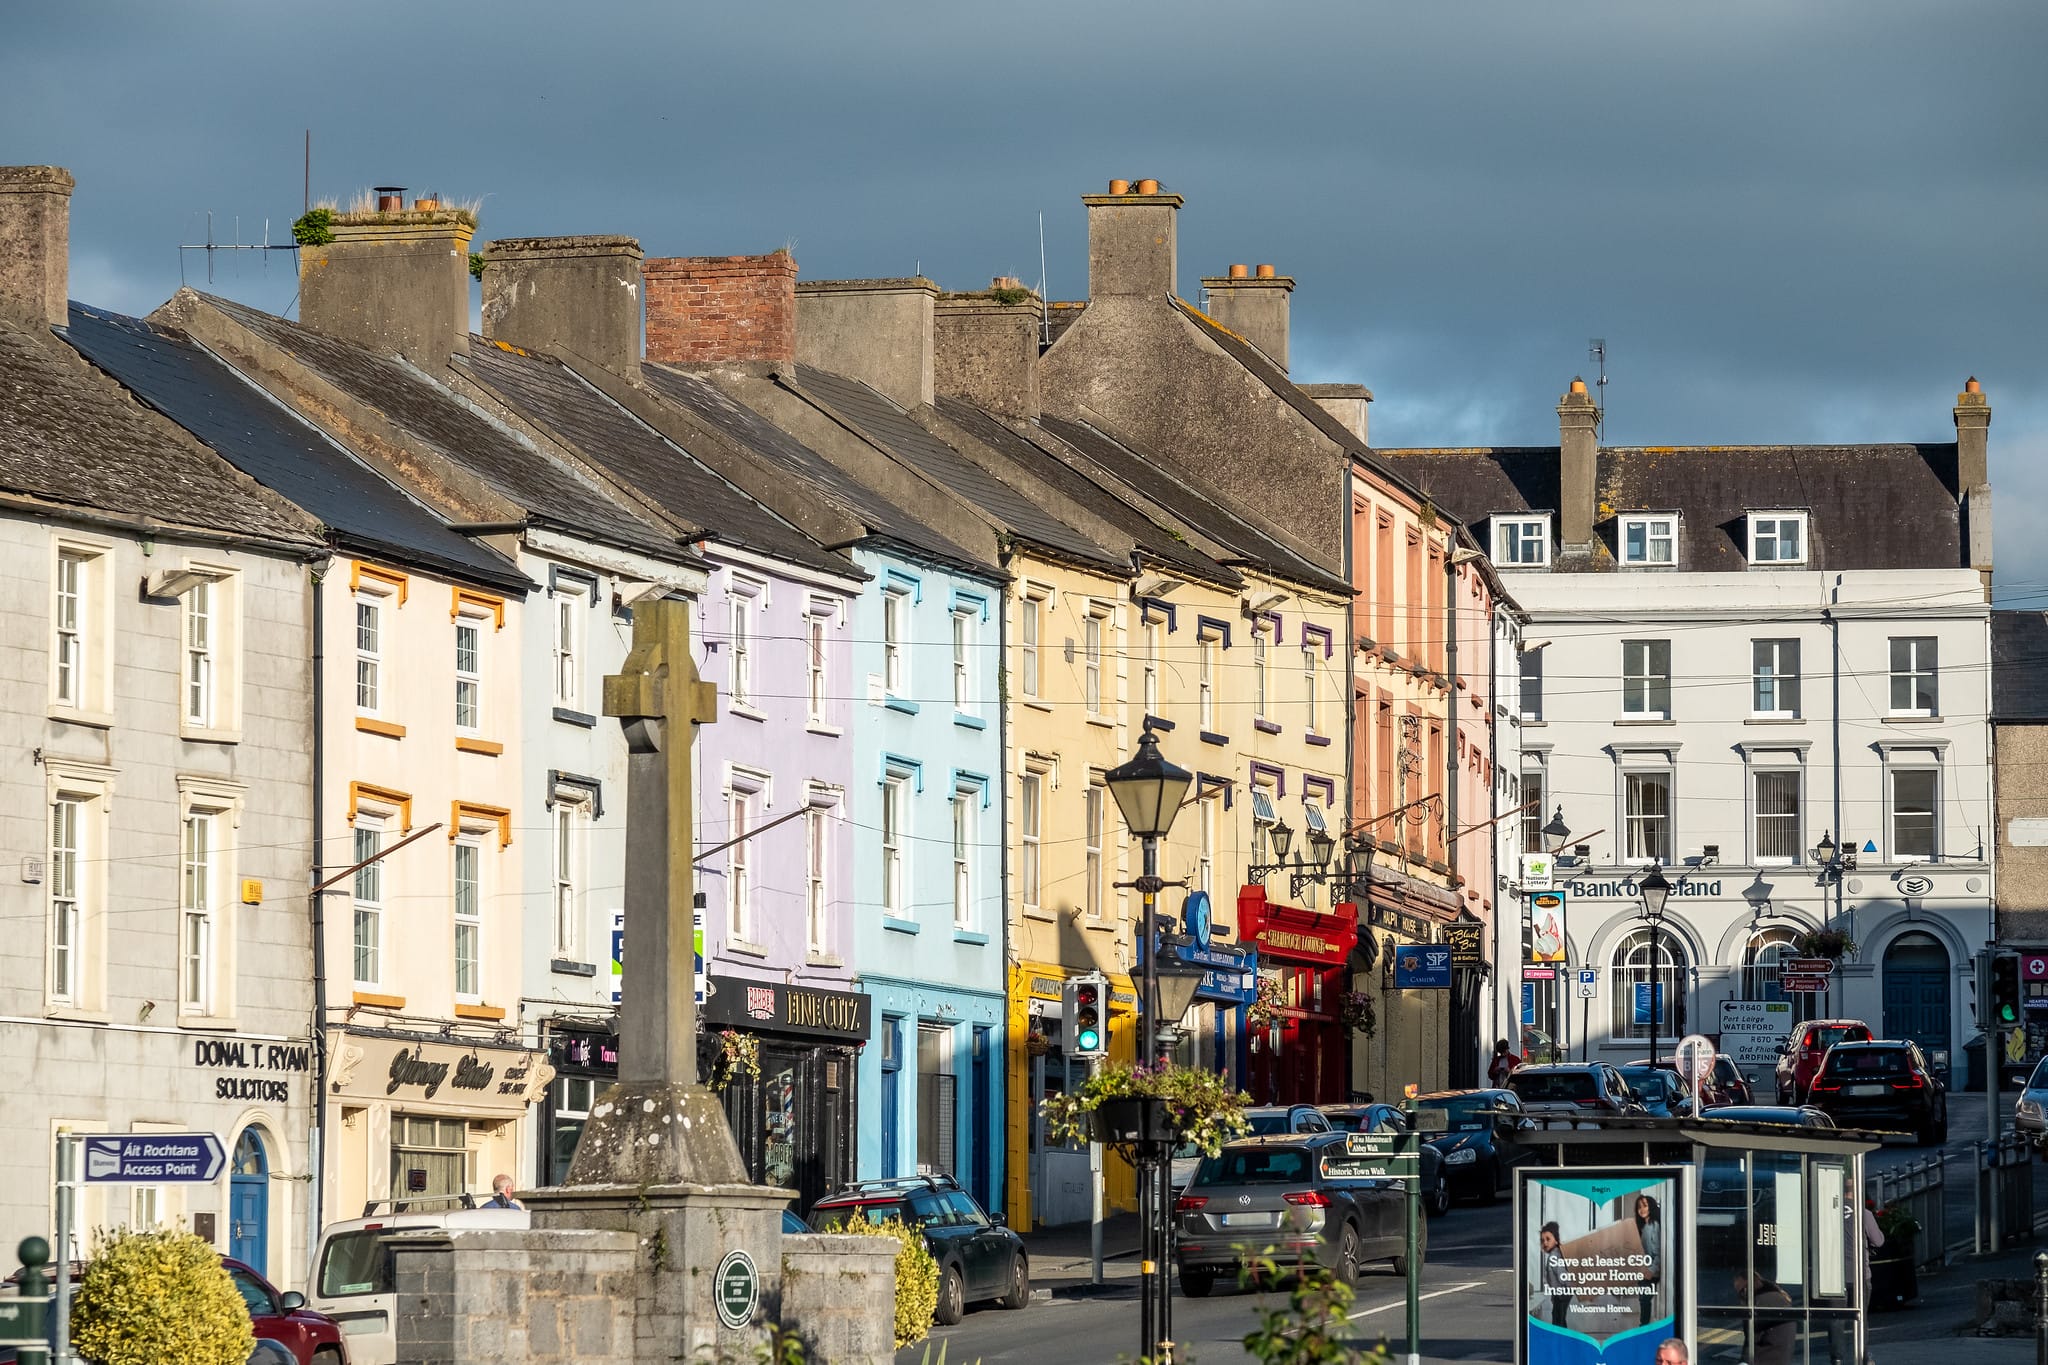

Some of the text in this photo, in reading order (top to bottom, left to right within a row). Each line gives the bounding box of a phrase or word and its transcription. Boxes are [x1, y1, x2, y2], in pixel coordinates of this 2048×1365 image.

[1573, 881, 1622, 897] Bank
[1626, 883, 1642, 896] o
[1453, 929, 1480, 942] Black
[1459, 939, 1477, 952] Bee
[1583, 972, 1591, 982] P
[747, 986, 775, 1013] BARBER
[786, 990, 860, 1031] FINE CUTZ
[195, 1040, 309, 1072] DONAL T. RYAN
[1684, 1060, 1709, 1071] BS
[216, 1077, 288, 1102] SOLICITORS
[123, 1143, 199, 1156] Áit Rochtana
[123, 1163, 197, 1175] Access Point
[1591, 1186, 1611, 1194] Begin
[1549, 1255, 1652, 1267] Save at least €50
[1560, 1270, 1644, 1284] on your Home
[1544, 1284, 1658, 1295] Insurance renewal.
[1569, 1304, 1633, 1313] Welcome Home.
